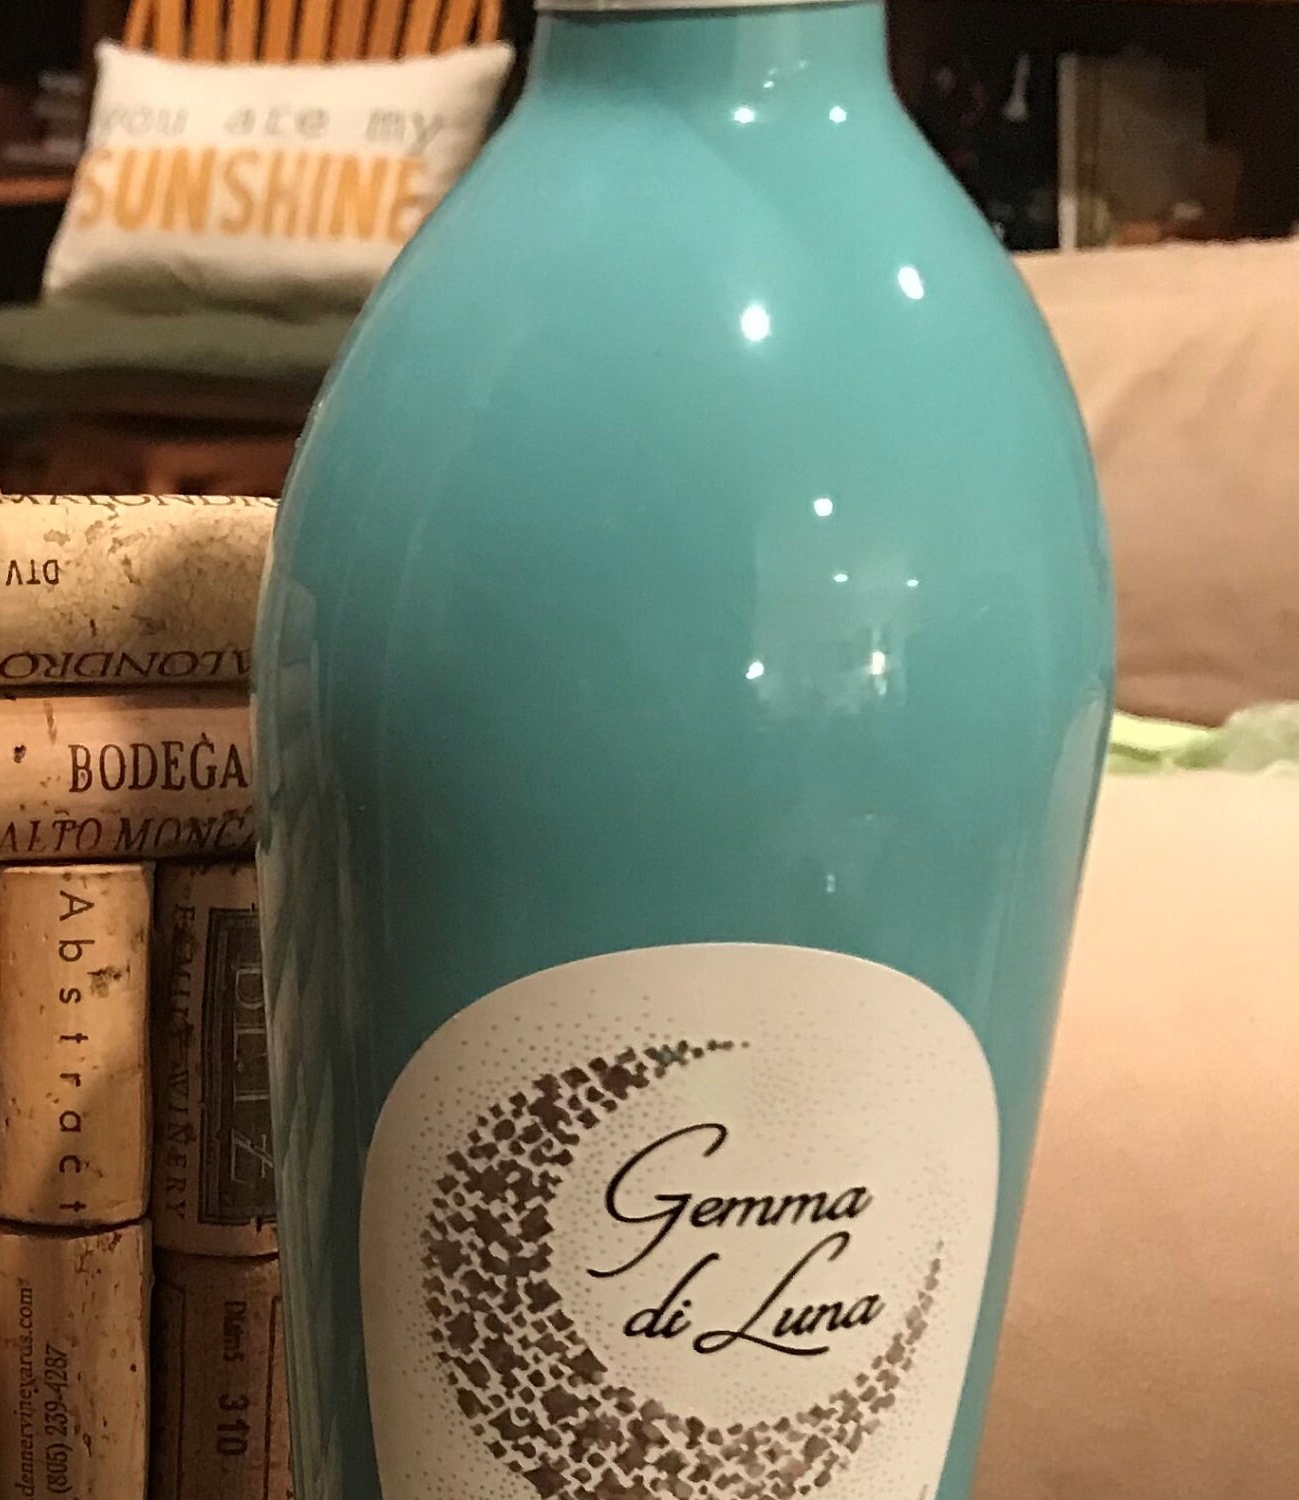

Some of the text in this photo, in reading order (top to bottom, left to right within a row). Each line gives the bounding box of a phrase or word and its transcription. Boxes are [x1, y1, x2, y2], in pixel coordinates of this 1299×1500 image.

[101, 106, 446, 152] you are my
[77, 146, 428, 244] SUNSHINE
[68, 740, 248, 793] BODEGA
[57, 889, 95, 1214] Abstract
[587, 1123, 875, 1278] Gemma
[624, 1231, 885, 1357] di Luna
[44, 1343, 72, 1494] (805) 239-4287
